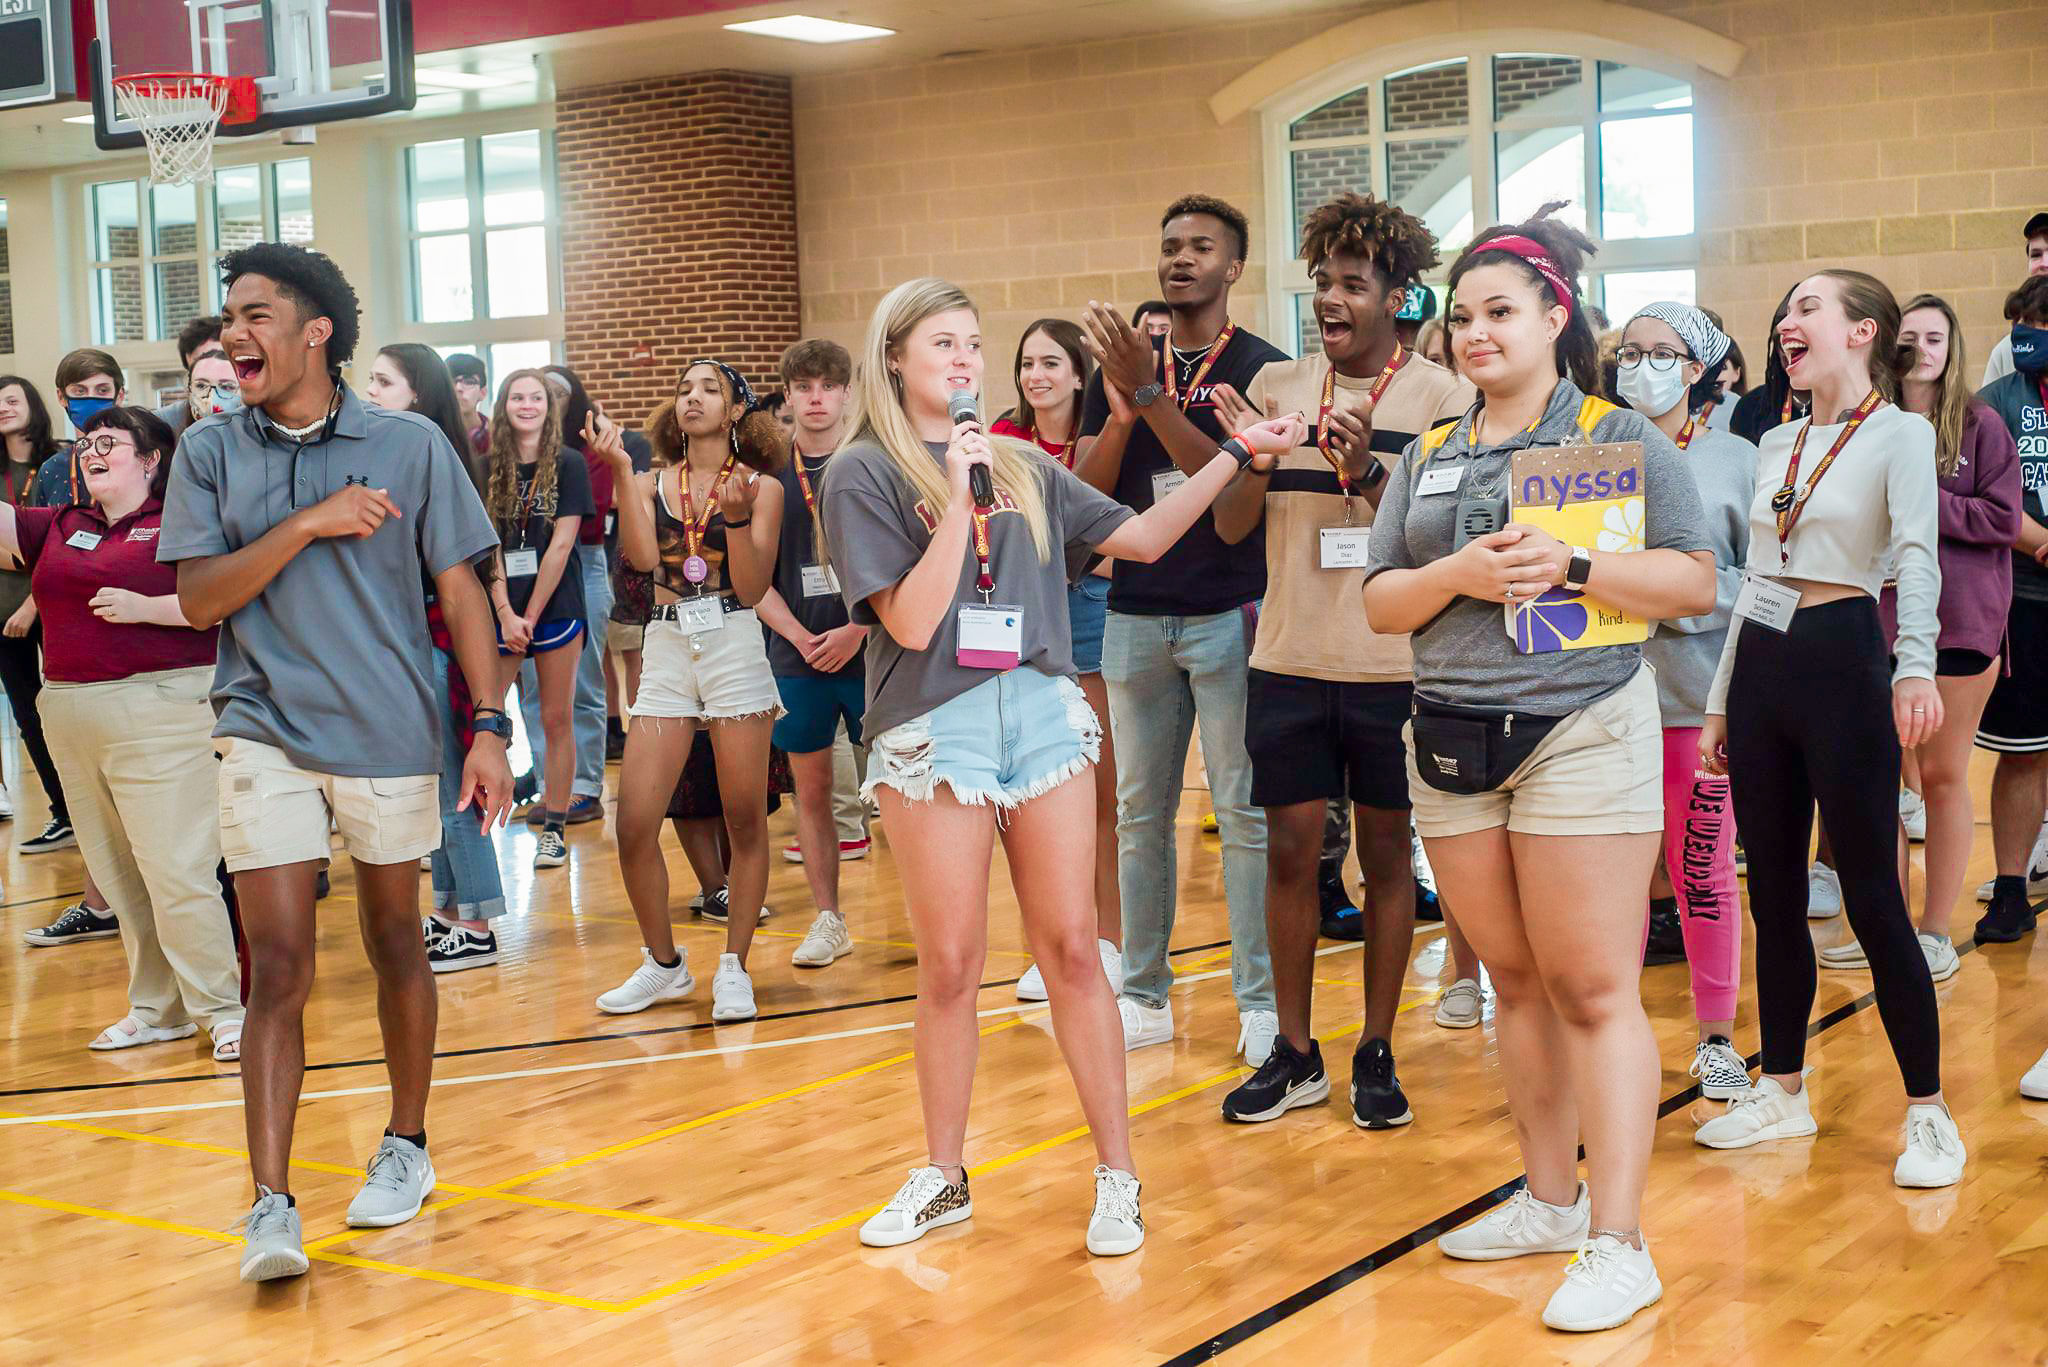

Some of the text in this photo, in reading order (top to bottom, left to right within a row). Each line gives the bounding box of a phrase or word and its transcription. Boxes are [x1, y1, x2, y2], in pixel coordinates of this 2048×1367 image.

[2021, 405, 2048, 432] ST
[1523, 467, 1637, 512] nyssa
[2021, 462, 2048, 490] CA
[1754, 592, 1782, 609] Lauren
[1690, 780, 1729, 814] WE
